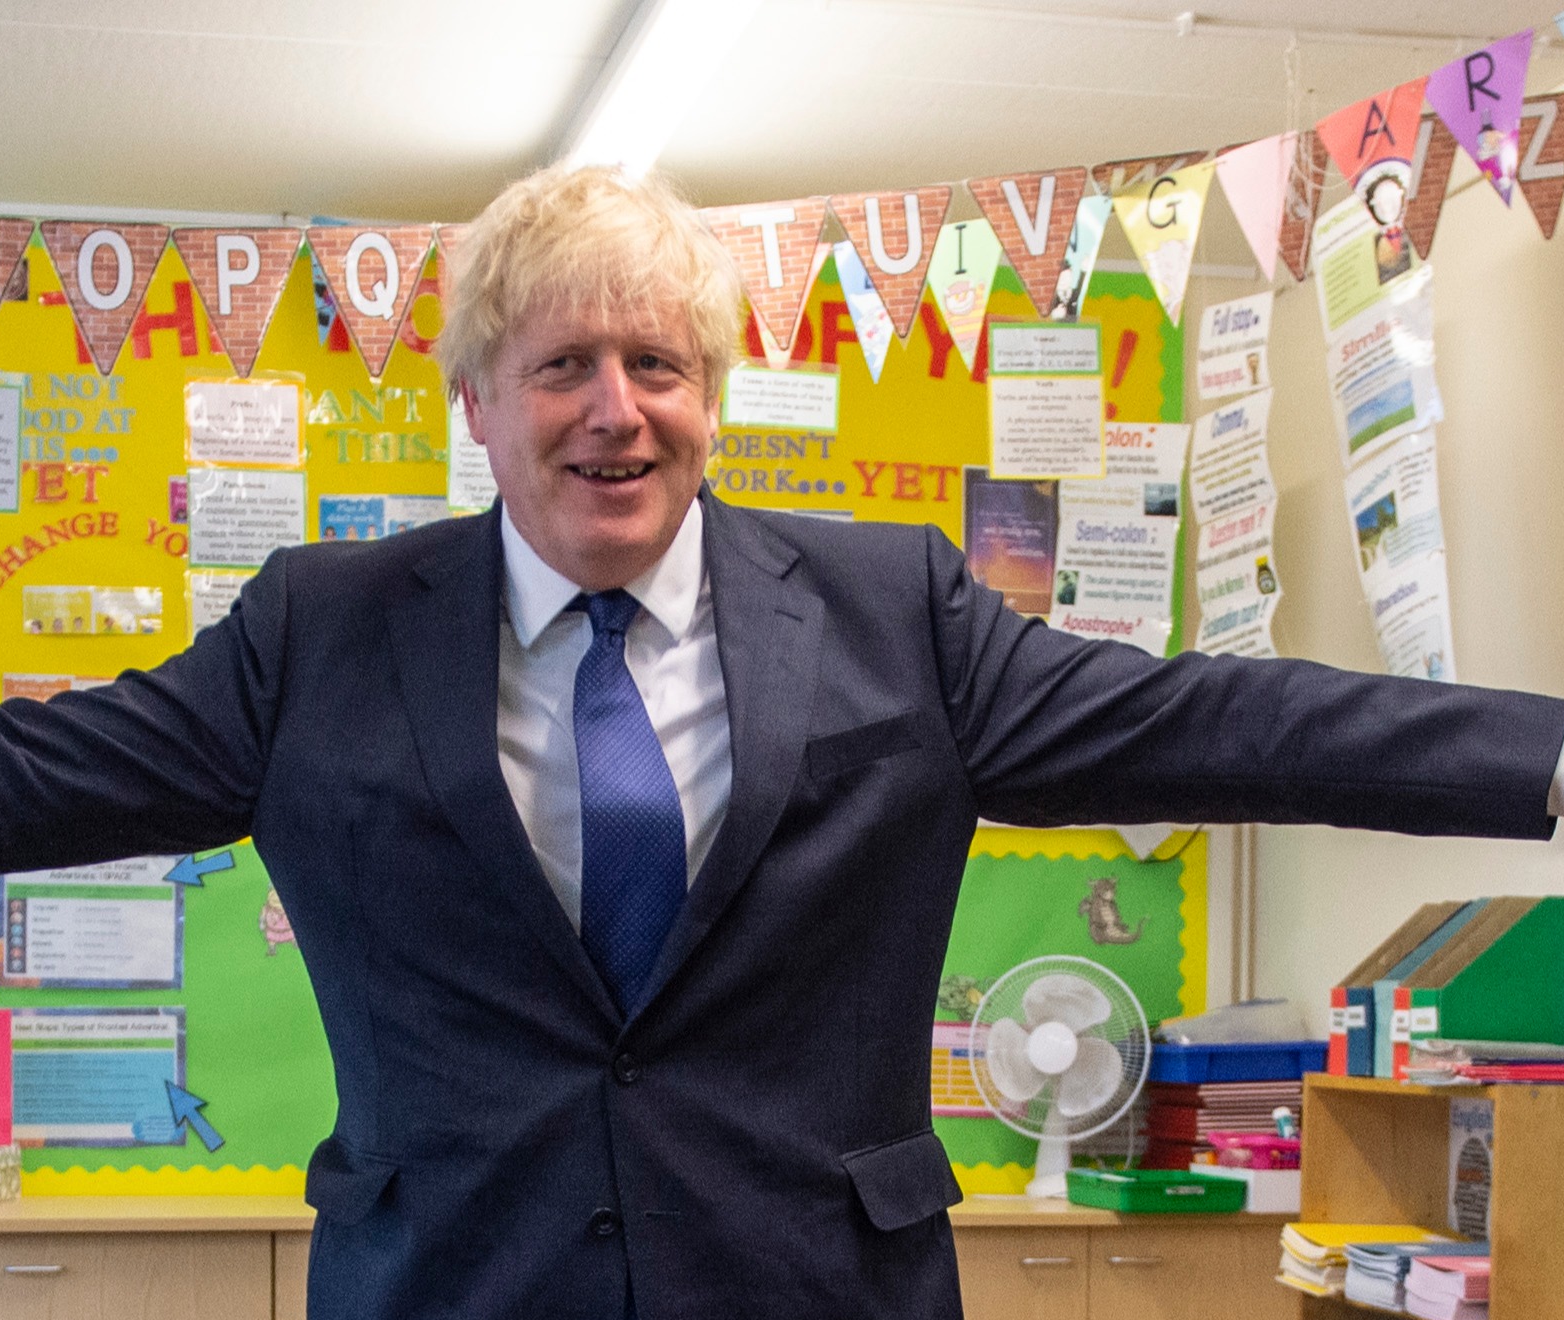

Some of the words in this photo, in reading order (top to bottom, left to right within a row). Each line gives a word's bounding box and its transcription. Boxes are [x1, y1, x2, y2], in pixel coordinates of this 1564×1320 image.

[1358, 101, 1395, 159] A
[1464, 51, 1501, 112] R
[77, 230, 133, 310] O
[216, 235, 260, 315] P
[345, 232, 399, 320] Q
[740, 207, 795, 288] T
[865, 194, 923, 275] U
[1001, 176, 1056, 256] V
[50, 374, 125, 400] NOT
[306, 387, 427, 424] AN'T
[95, 409, 136, 433] AT
[1105, 427, 1142, 448] olon
[22, 463, 109, 503] ET
[853, 461, 958, 502] YET
